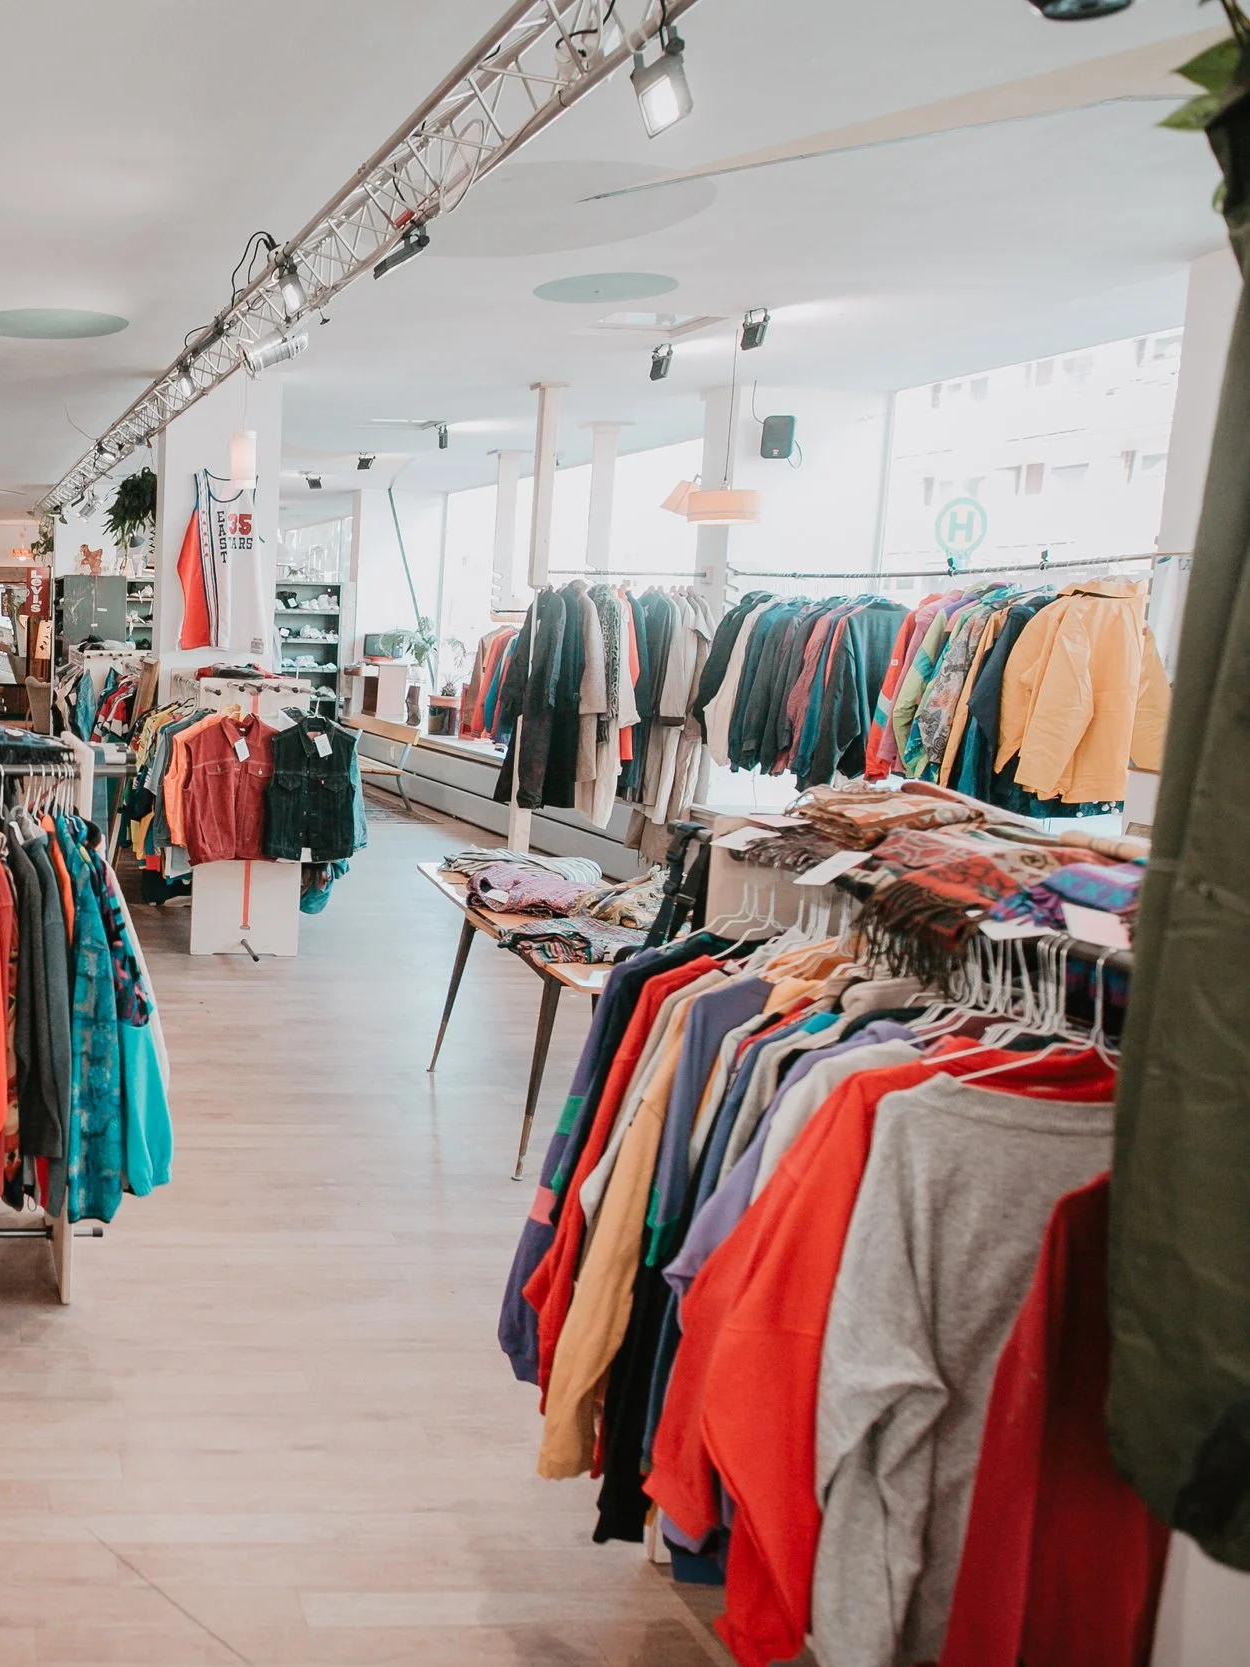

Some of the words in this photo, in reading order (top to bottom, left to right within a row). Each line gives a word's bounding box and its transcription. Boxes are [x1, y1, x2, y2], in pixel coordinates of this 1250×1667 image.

[217, 511, 228, 563] EAST
[228, 513, 252, 536] 35
[947, 511, 974, 542] H
